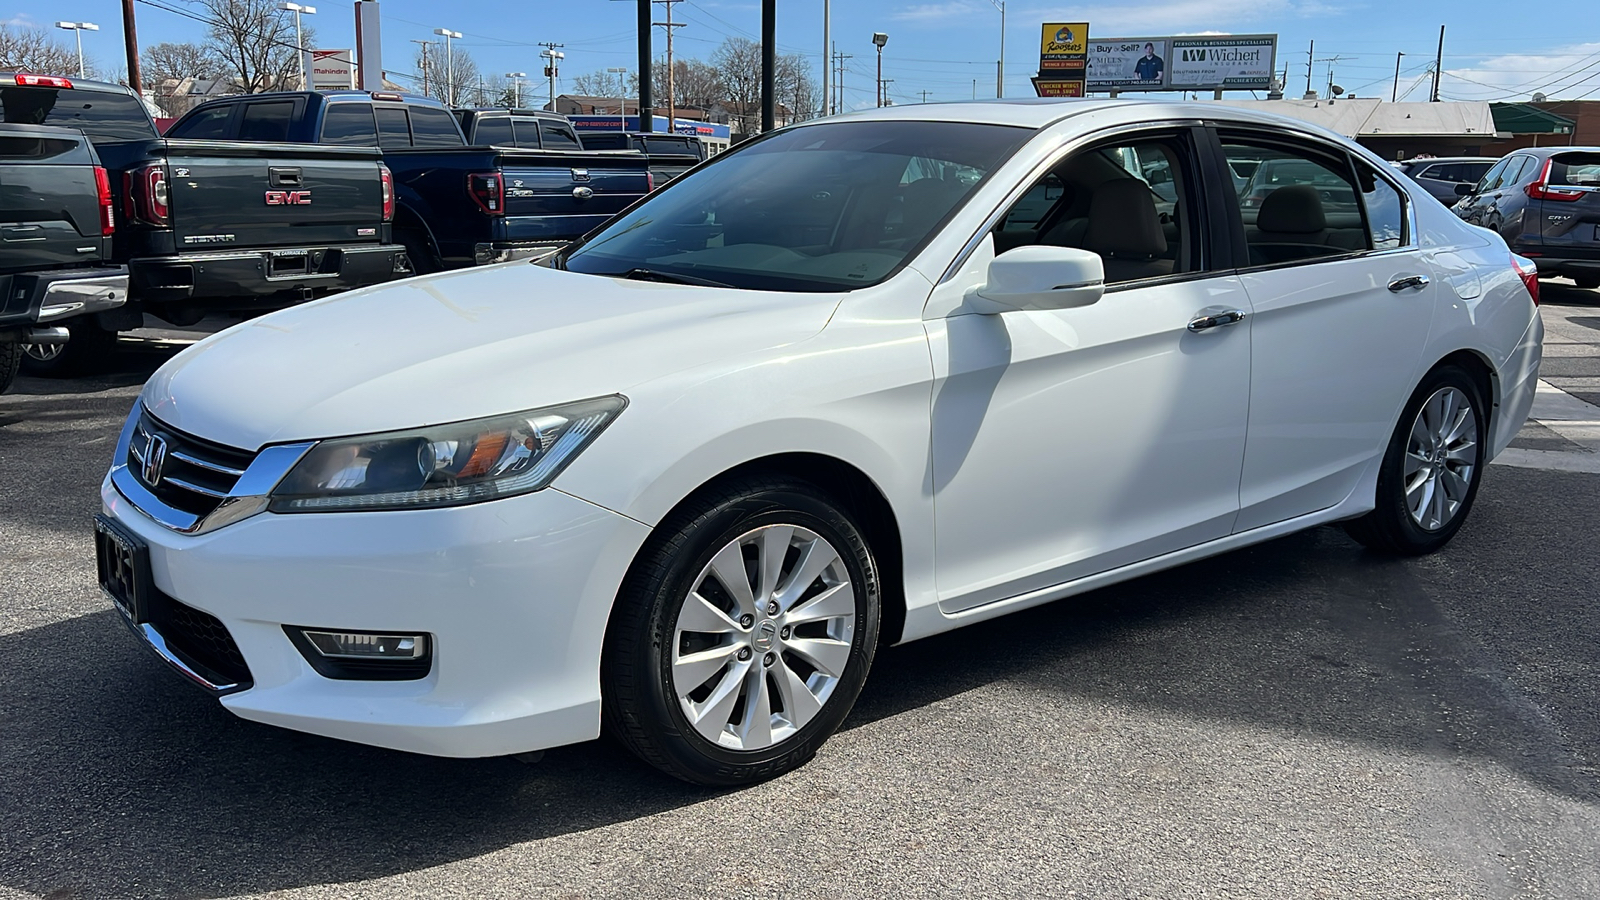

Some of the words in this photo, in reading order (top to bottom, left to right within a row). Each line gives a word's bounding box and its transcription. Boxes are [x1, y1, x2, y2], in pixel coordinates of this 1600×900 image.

[1047, 41, 1082, 53] Roosters
[1096, 45, 1113, 53] Buy
[1120, 44, 1140, 52] Sell?
[1209, 48, 1260, 61] Wichert
[265, 191, 311, 205] GMC
[184, 234, 235, 243] SIERRA
